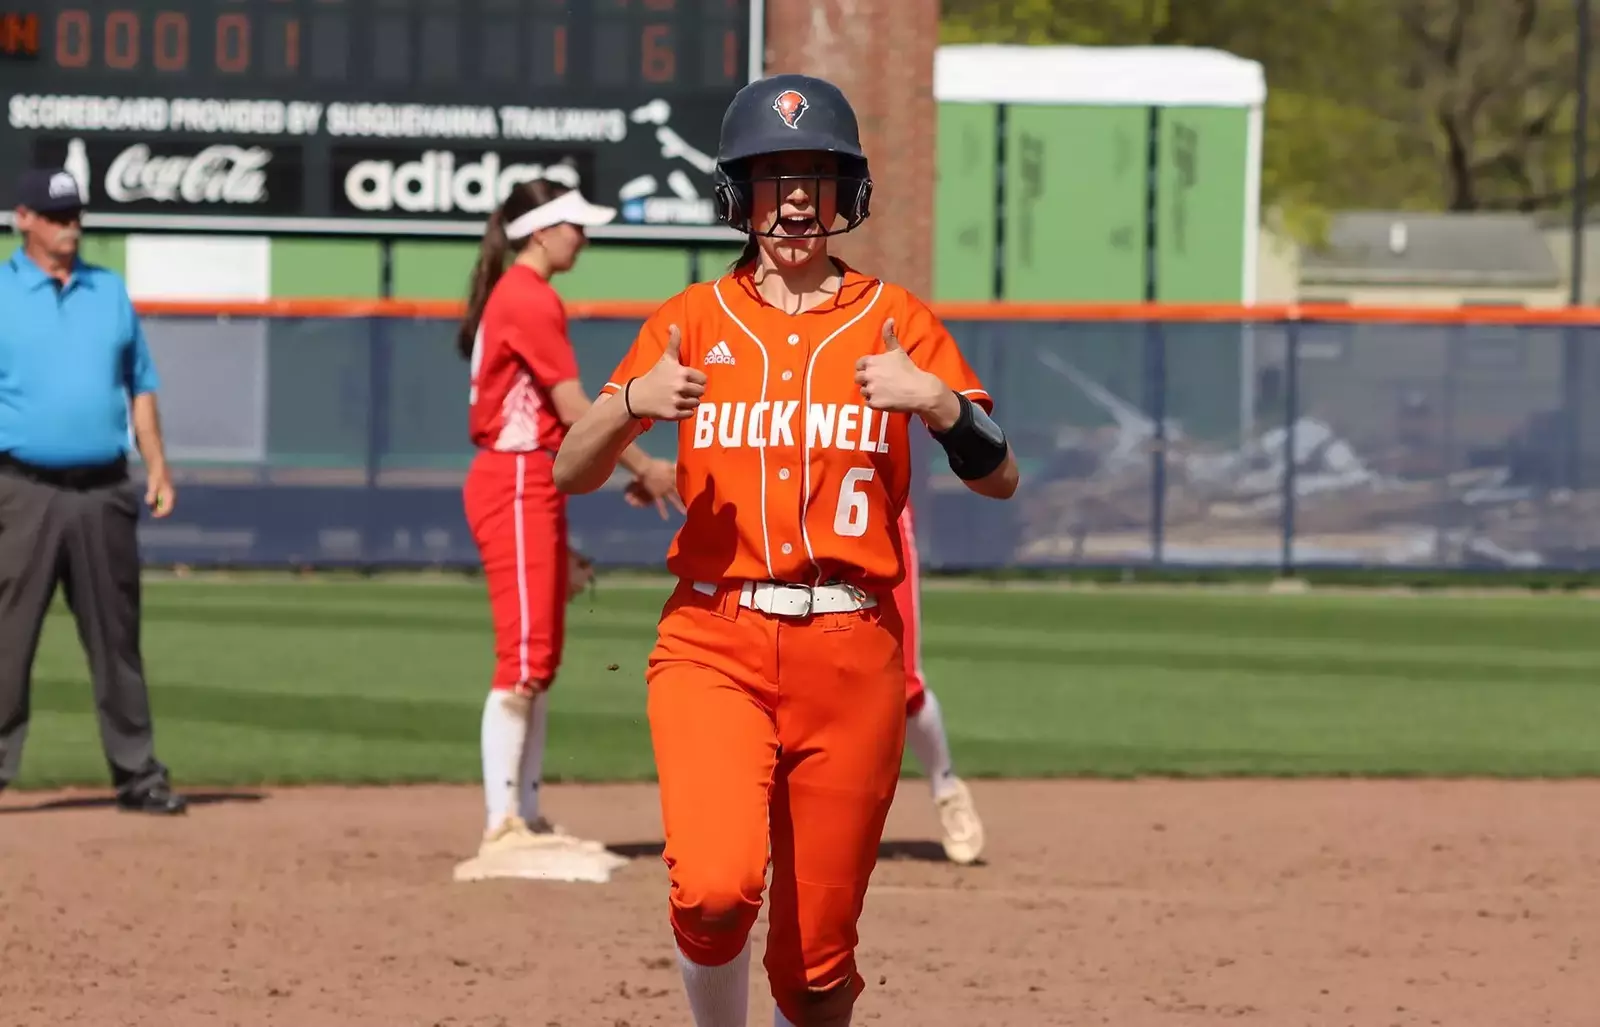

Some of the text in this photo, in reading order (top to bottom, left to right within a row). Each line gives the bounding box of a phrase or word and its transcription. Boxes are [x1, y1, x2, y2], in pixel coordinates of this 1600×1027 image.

[56, 9, 91, 68] 0
[104, 10, 139, 69] 0
[153, 12, 190, 71] 0
[215, 14, 251, 72] 0
[641, 24, 675, 82] 6
[9, 95, 627, 142] SCOREBOARD PROVIDED BY SUSQUEHANNA TRAILWAYS
[704, 355, 735, 366] adidas
[833, 467, 876, 538] 6
